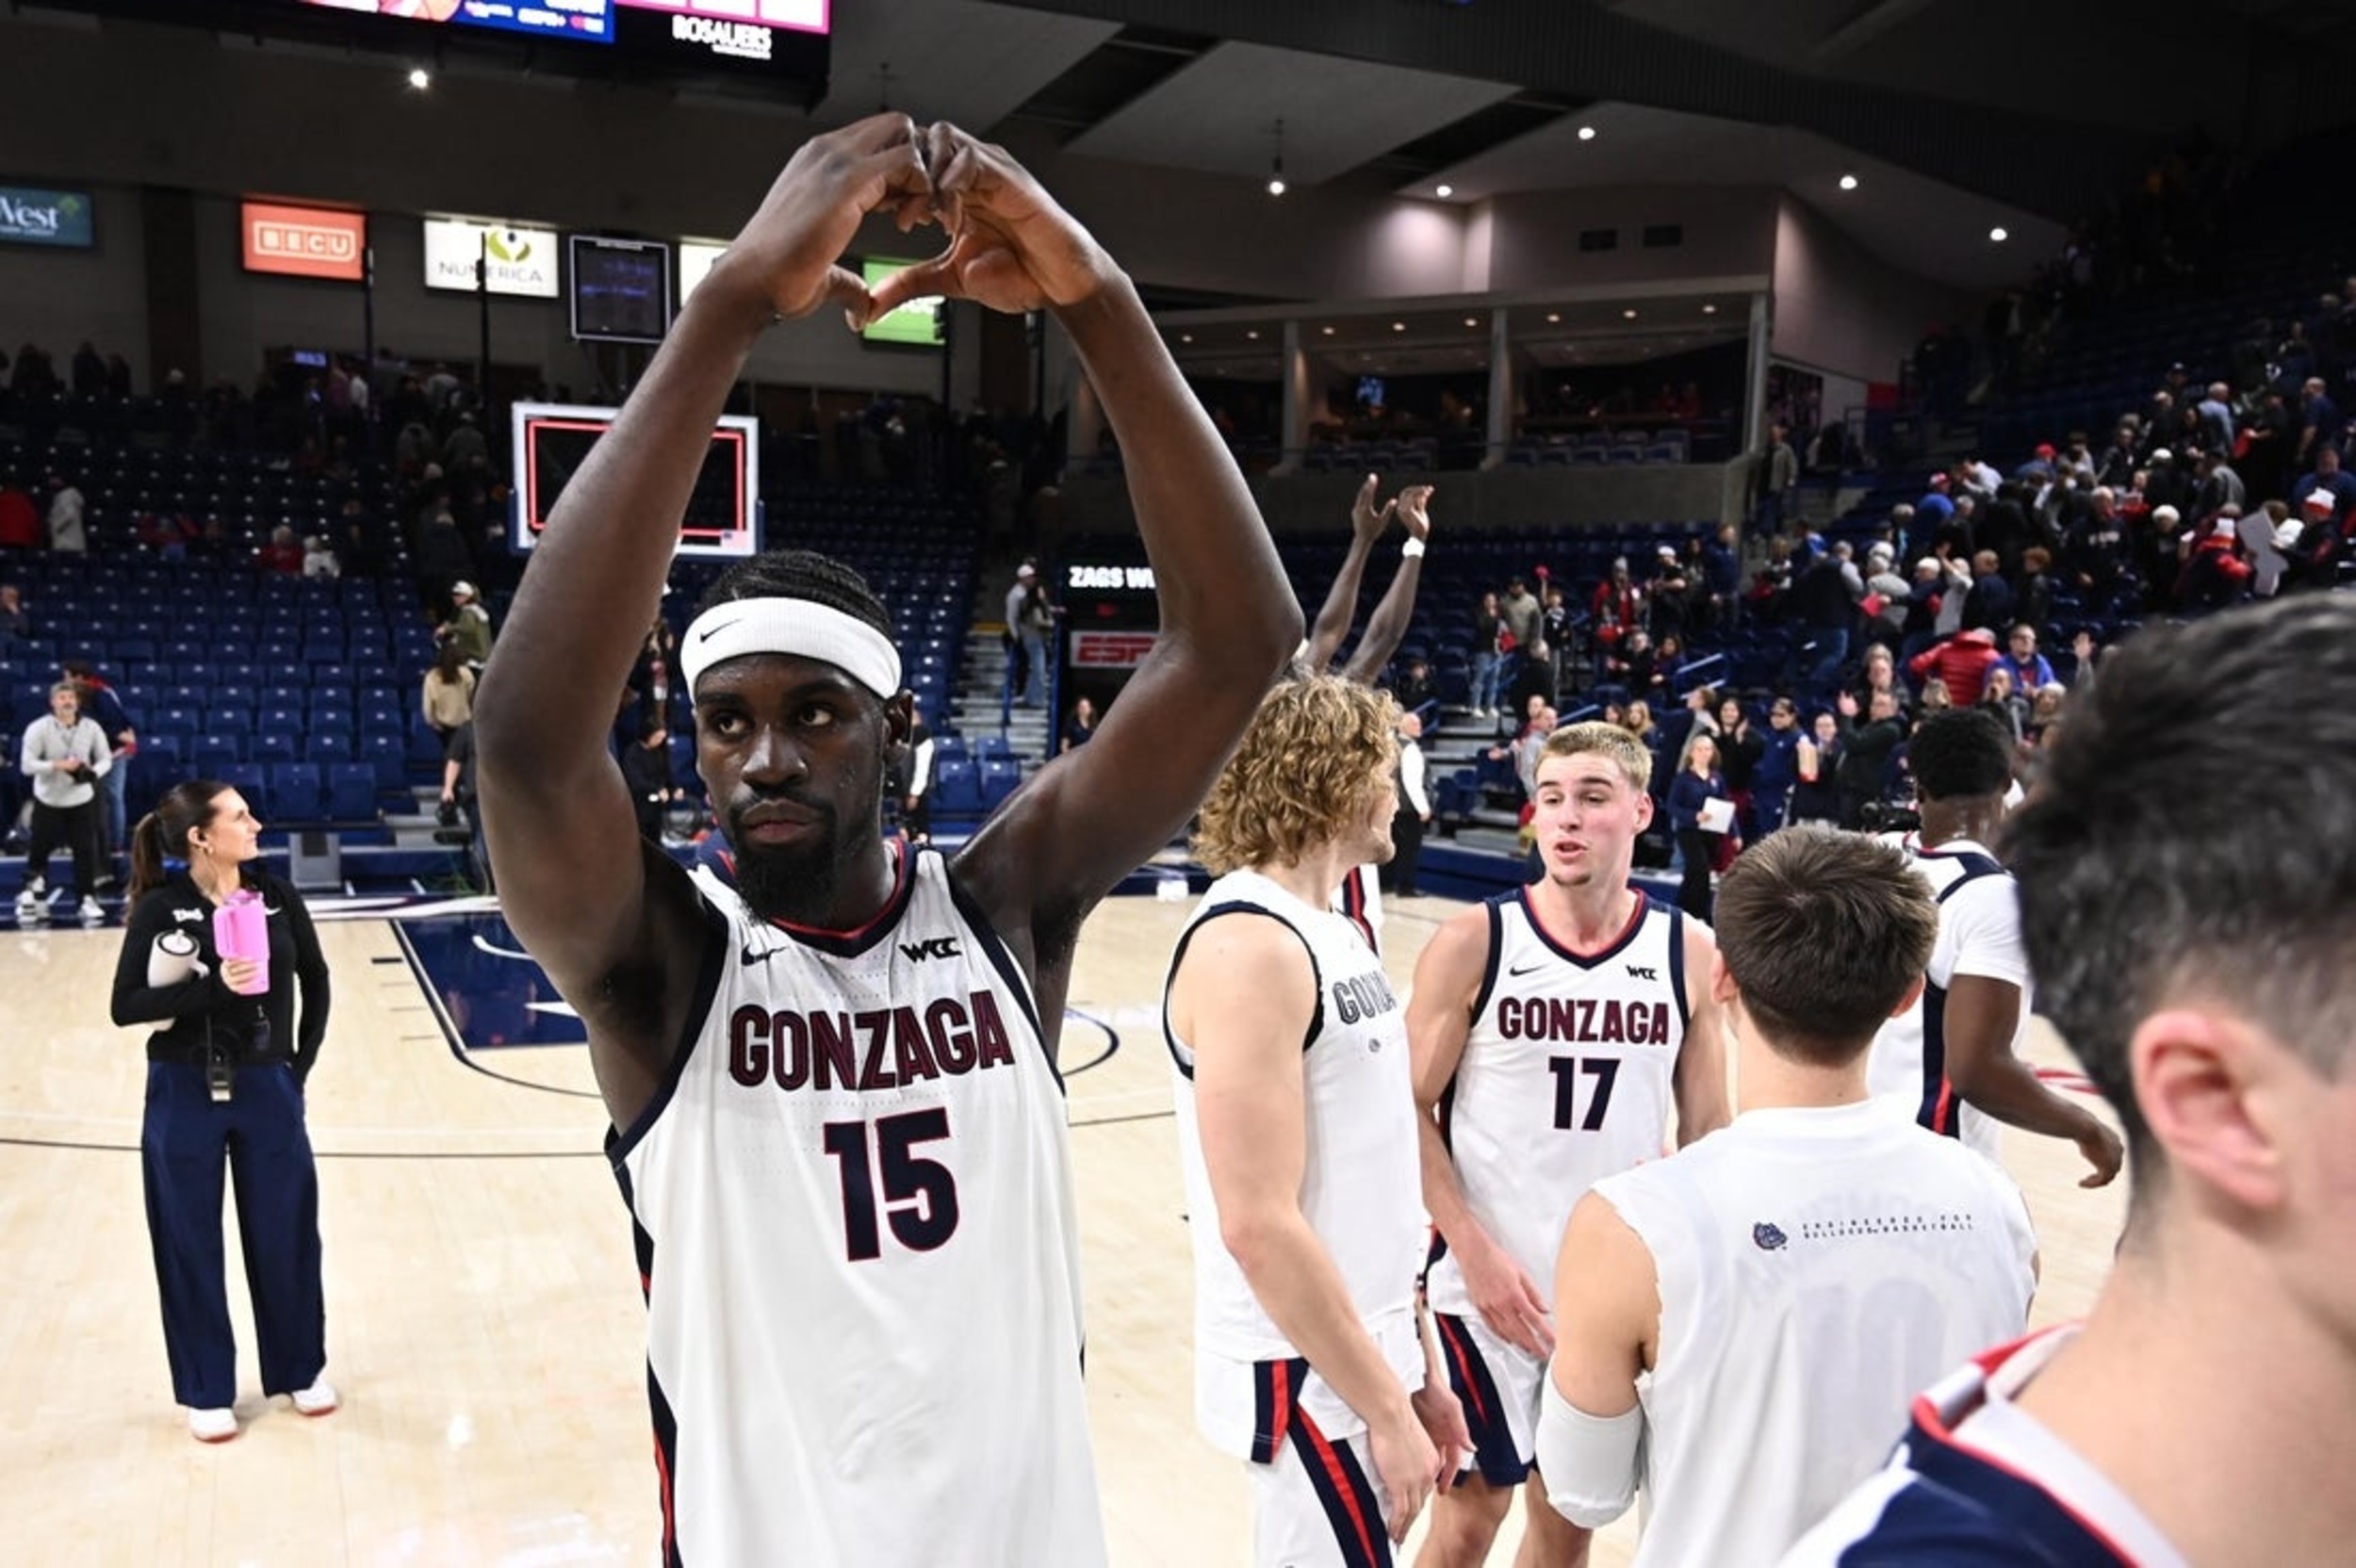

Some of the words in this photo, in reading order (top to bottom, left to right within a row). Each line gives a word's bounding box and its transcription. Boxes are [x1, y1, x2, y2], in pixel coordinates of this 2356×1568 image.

[263, 229, 348, 254] BECU
[1069, 566, 1124, 587] ZAGS
[1125, 567, 1156, 588] WI
[1077, 635, 1154, 662] ESP
[900, 937, 961, 963] WCC
[1497, 996, 1669, 1046] GONZAGA
[728, 989, 1016, 1092] GONZAGA
[1548, 1055, 1621, 1132] 17
[823, 1105, 959, 1263] 15
